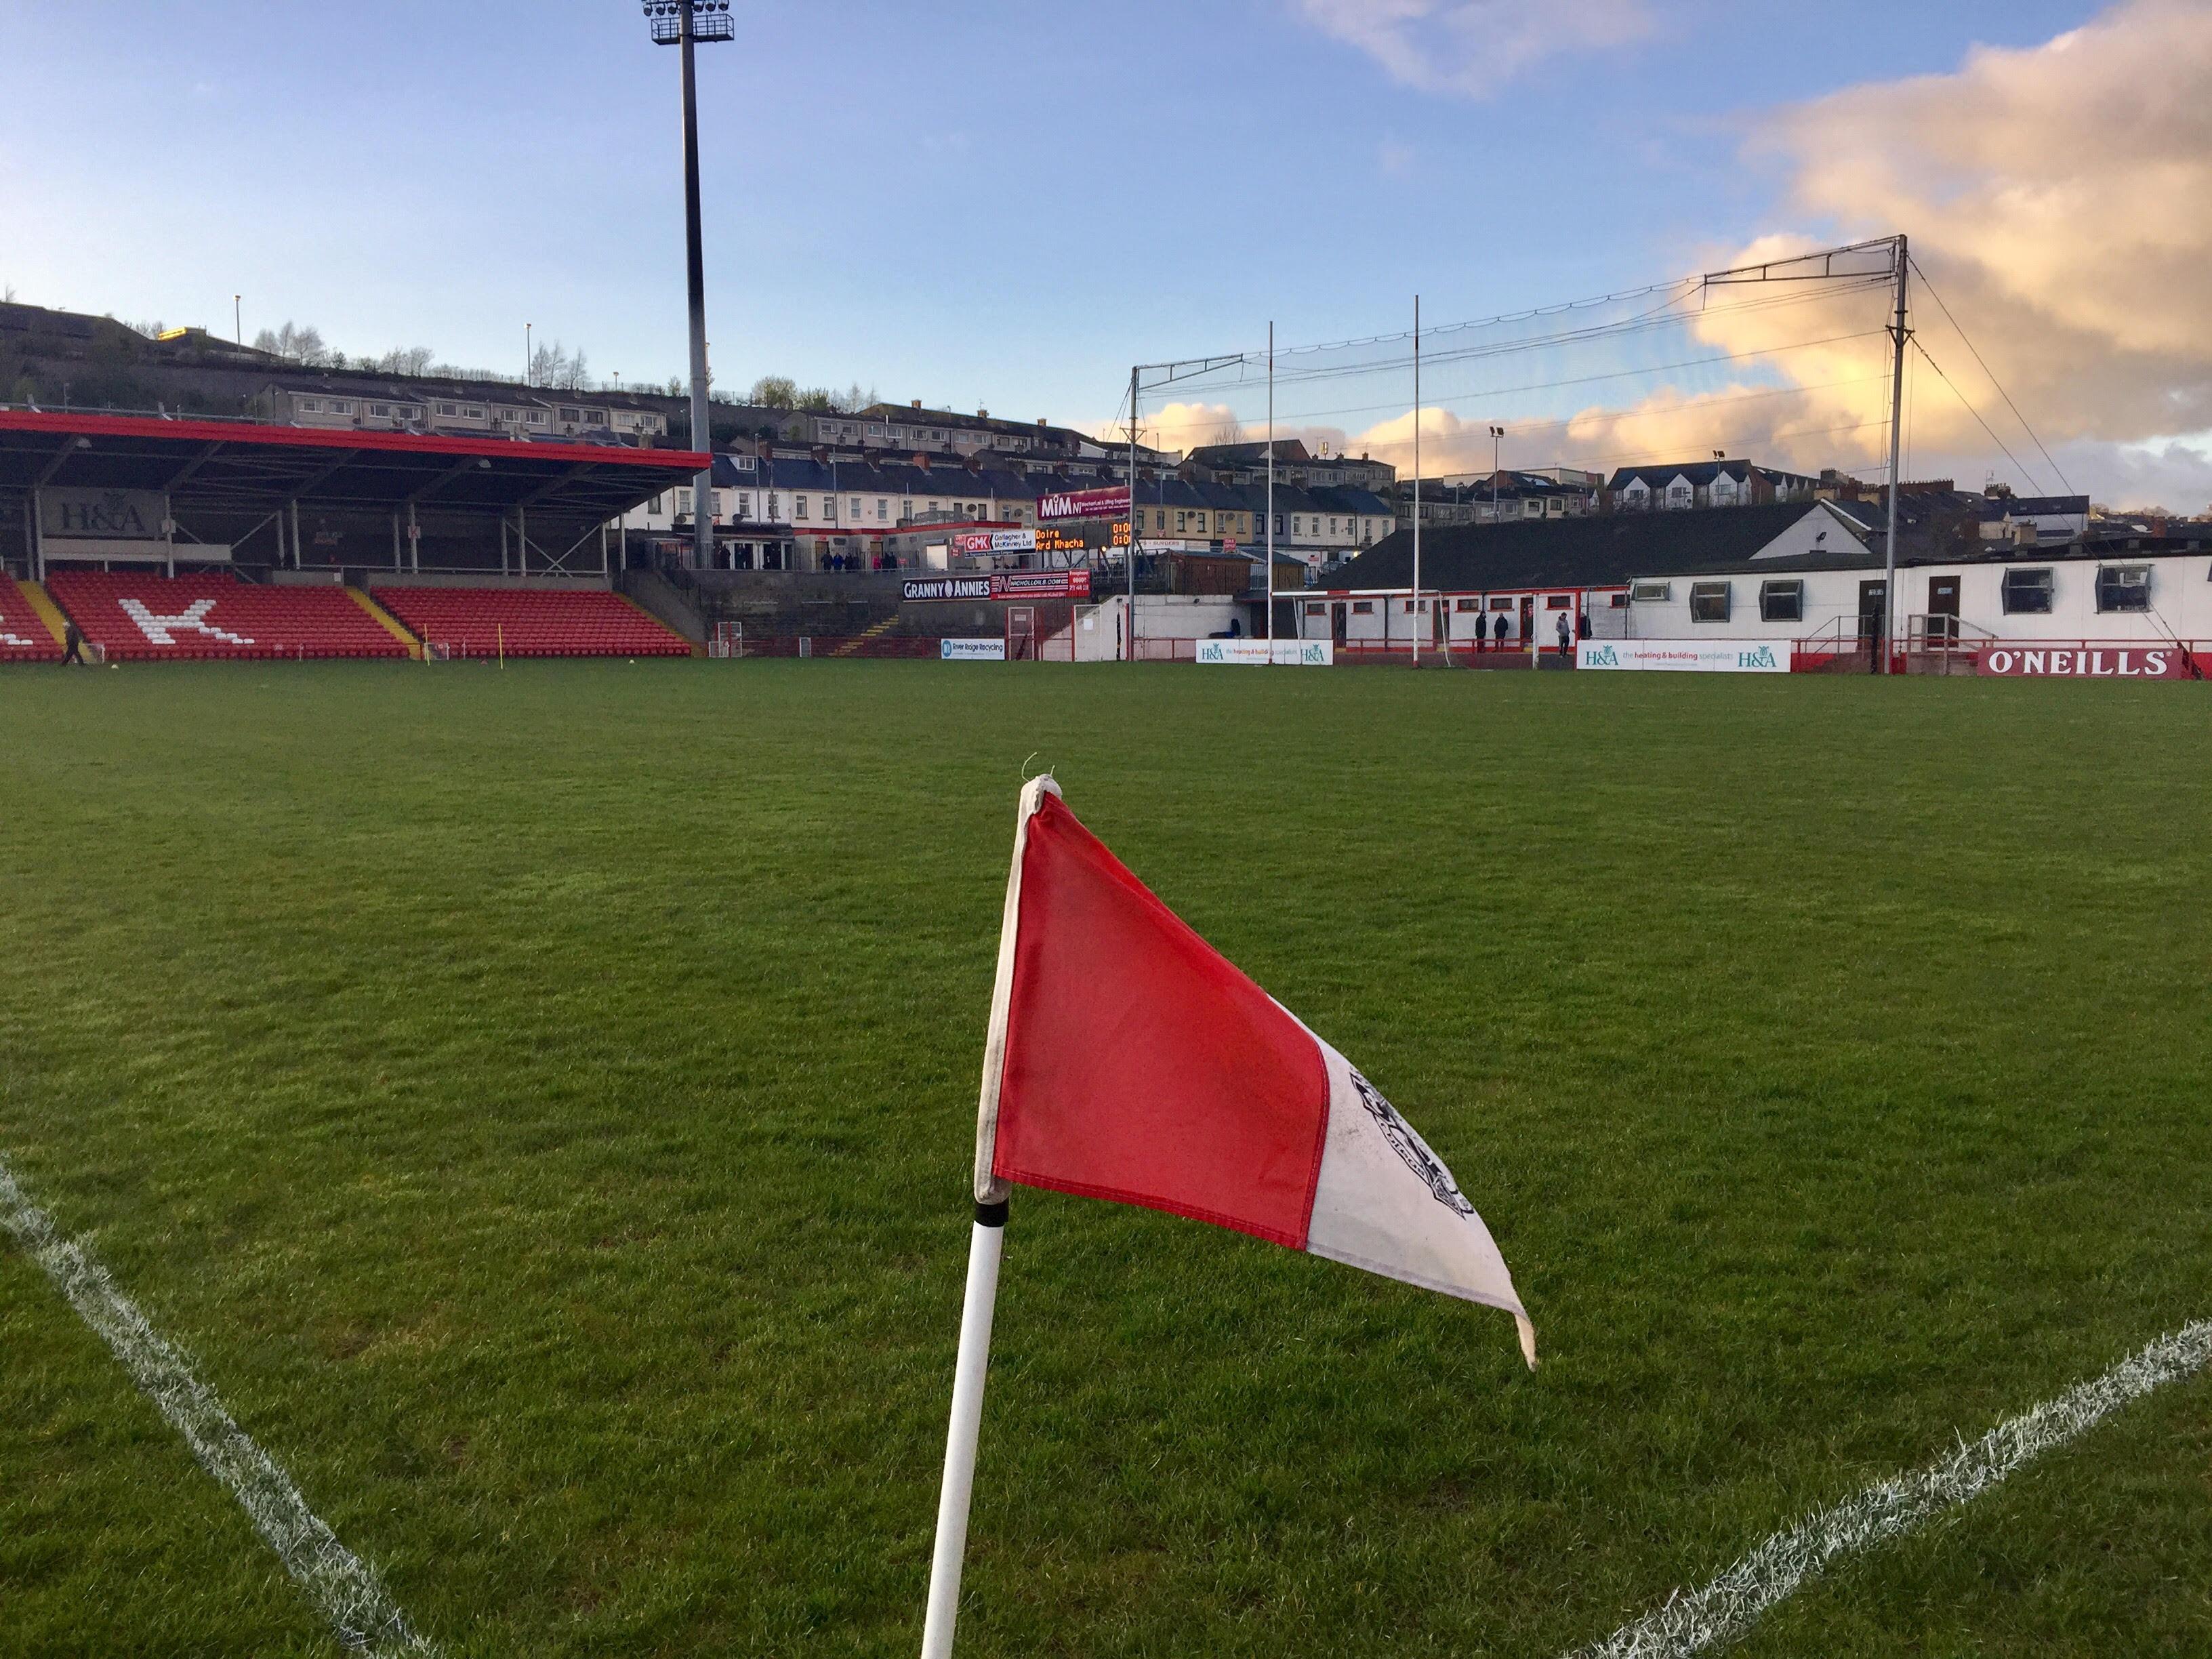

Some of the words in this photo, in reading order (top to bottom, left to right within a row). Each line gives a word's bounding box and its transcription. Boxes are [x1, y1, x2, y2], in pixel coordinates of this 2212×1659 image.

[966, 536, 988, 550] GMK
[994, 533, 1021, 541] Gallagher
[994, 541, 1021, 549] McKinney
[1036, 540, 1050, 551] Ard
[1054, 539, 1084, 549] Mhacha
[904, 581, 945, 598] GRANNY
[954, 580, 990, 596] ANNIES
[979, 643, 1003, 653] Recycling
[1202, 648, 1224, 661] H&A
[1300, 648, 1324, 662] H&A
[1586, 651, 1619, 666] H&A
[1635, 651, 1661, 660] heating
[1668, 652, 1698, 661] building
[1699, 653, 1734, 661] specialists
[1738, 651, 1777, 668] H&A
[1988, 651, 2167, 676] O'NEILLS
